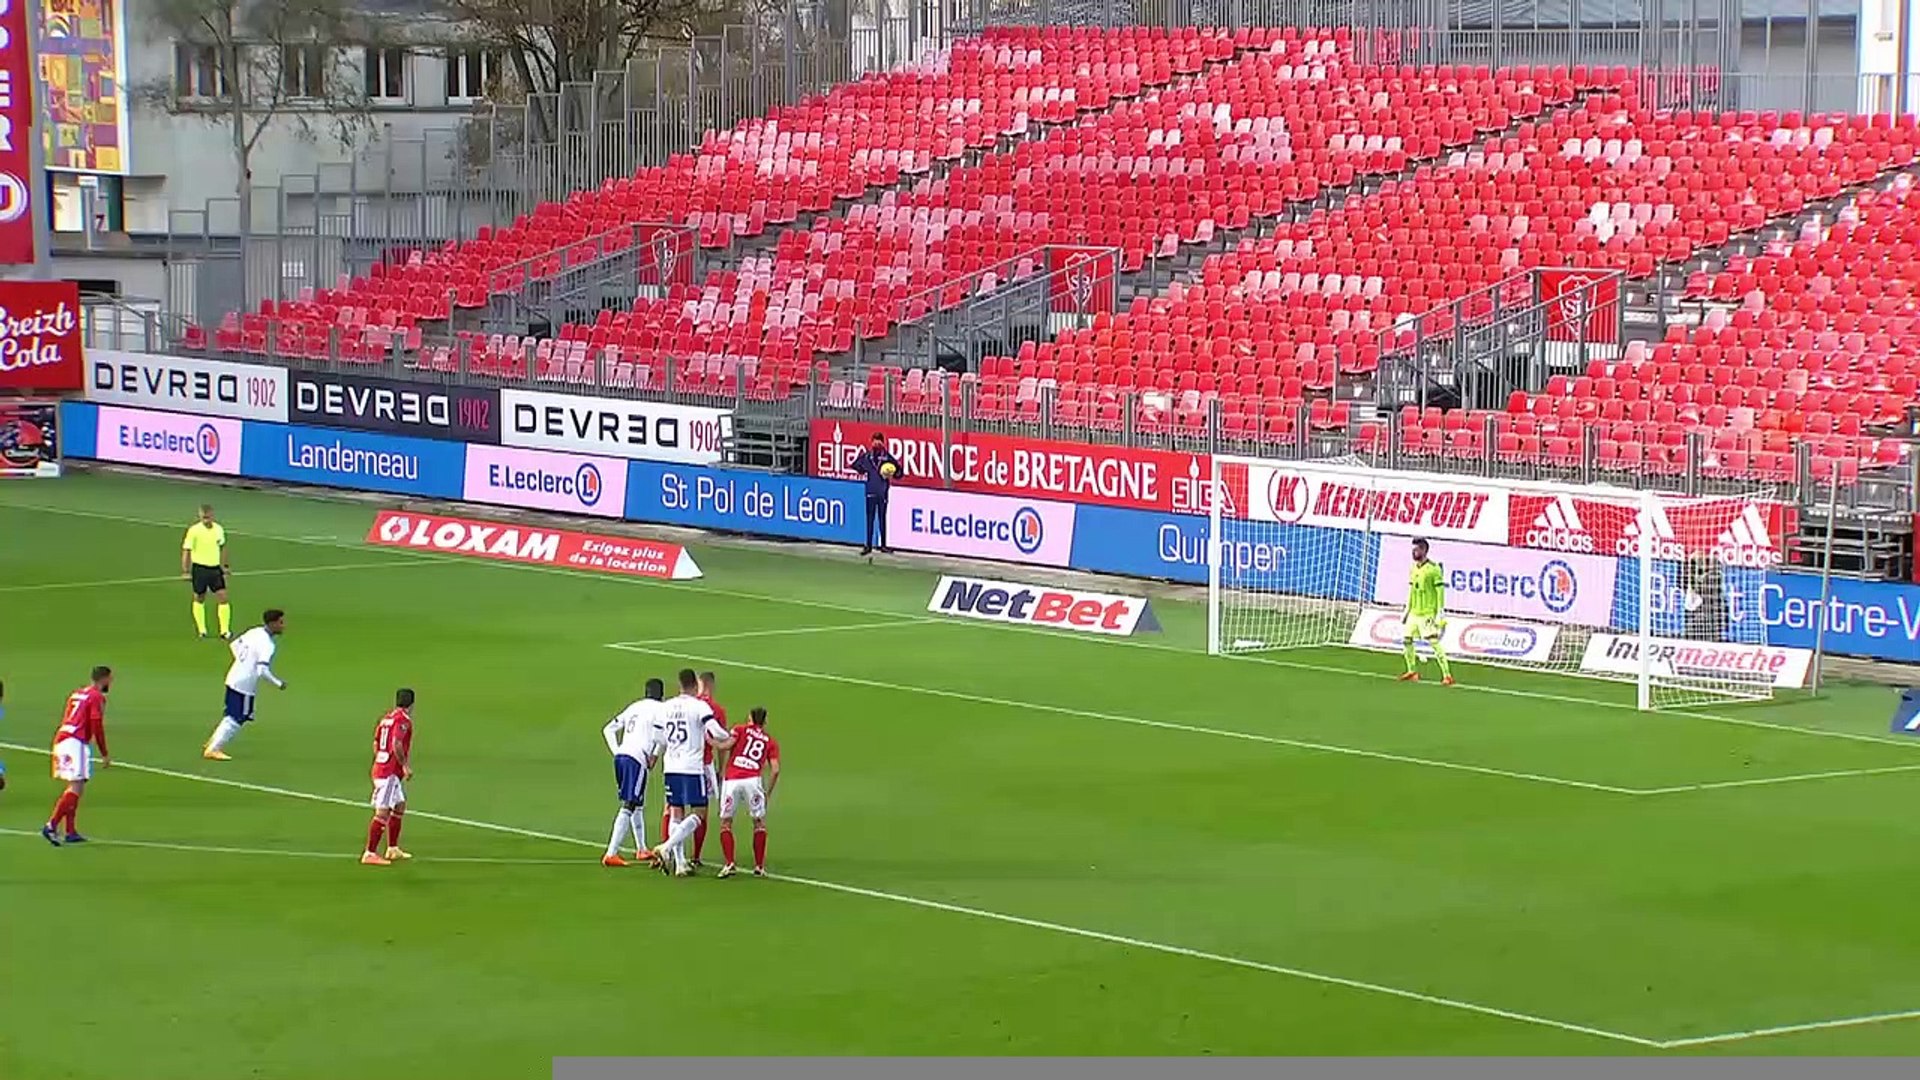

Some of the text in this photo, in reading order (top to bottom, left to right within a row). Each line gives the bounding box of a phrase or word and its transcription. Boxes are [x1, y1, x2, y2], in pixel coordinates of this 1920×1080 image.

[0, 336, 62, 372] Cola
[246, 377, 276, 408] 1902
[457, 398, 489, 430] 1902
[119, 425, 195, 453] E.Leclerc
[689, 420, 721, 452] 1902
[288, 433, 420, 480] Landerneau
[887, 438, 1158, 501] PRINCE de BRETAGNE
[489, 464, 573, 496] E.Leclerc
[661, 473, 845, 526] St Pol de Léon
[409, 520, 560, 562] LOXAM
[910, 509, 1009, 542] E.Leclerc
[1525, 527, 1593, 552] adidas
[569, 552, 668, 573] de la location
[582, 540, 665, 560] Exigez plus
[1159, 523, 1287, 578] Quimper
[1710, 543, 1783, 568] adidas
[940, 579, 1130, 629] NetBet
[70, 700, 81, 721] 7
[665, 721, 688, 744] 25
[742, 735, 765, 761] 18
